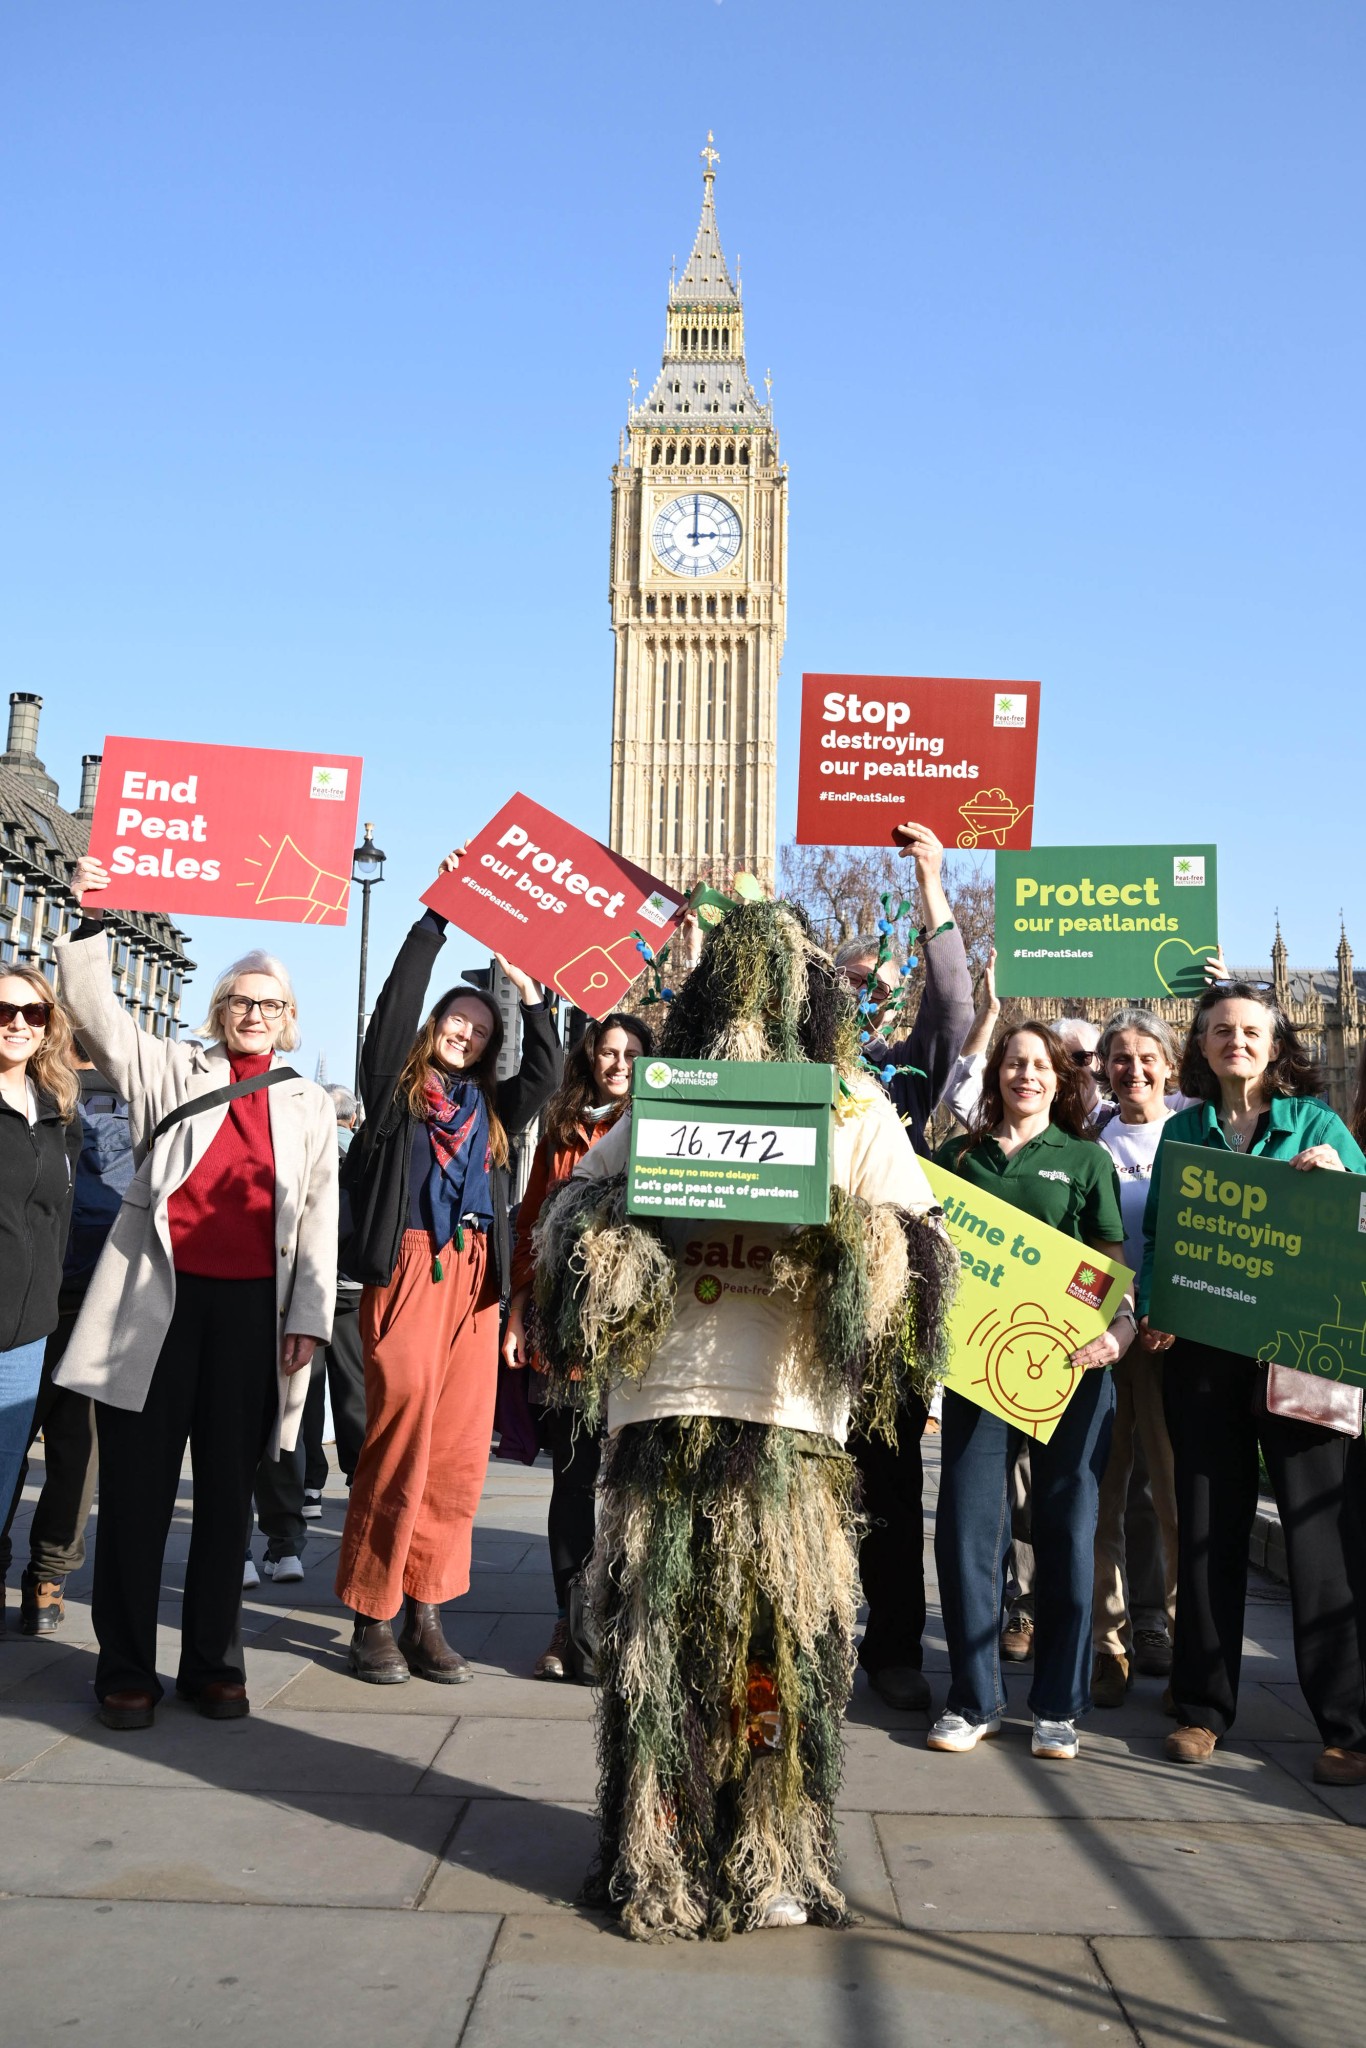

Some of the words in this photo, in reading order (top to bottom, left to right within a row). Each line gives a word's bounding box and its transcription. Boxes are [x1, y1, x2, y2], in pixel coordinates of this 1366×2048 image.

[822, 692, 911, 732] Stop
[820, 730, 945, 757] destroying
[820, 760, 859, 775] our
[864, 758, 979, 781] peatlands
[121, 771, 198, 804] End
[312, 786, 345, 795] Peat-free
[819, 791, 906, 804] #EndPeatSales
[116, 807, 208, 842] Peat
[110, 846, 221, 882] Sales
[496, 824, 626, 919] Protect
[480, 853, 518, 880] our
[515, 873, 568, 914] bogs
[1015, 878, 1161, 906] Protect
[461, 876, 529, 924] #EndPeatSales
[1014, 917, 1054, 932] our
[1058, 913, 1179, 936] peatlands
[1013, 949, 1094, 958] #EndPeatSales
[671, 1069, 718, 1079] Peat-free
[671, 1077, 718, 1086] PARTNERSHIP
[635, 1165, 668, 1176] People
[669, 1169, 685, 1178] say
[700, 1170, 725, 1178] more
[725, 1170, 760, 1182] delays:
[633, 1195, 662, 1204] once
[664, 1196, 687, 1206] and
[688, 1196, 706, 1207] for
[707, 1197, 727, 1209] all.
[663, 1182, 684, 1194] get
[685, 1183, 713, 1195] peat
[714, 1184, 735, 1195] out
[736, 1185, 750, 1196] of
[750, 1187, 799, 1199] gardens
[1180, 1165, 1267, 1219] Stop
[943, 1196, 1005, 1246] time
[1010, 1234, 1041, 1266] to
[1177, 1207, 1302, 1256] destroying
[684, 1234, 773, 1270] sale
[1174, 1240, 1213, 1262] our
[1217, 1244, 1274, 1279] bogs
[1069, 1282, 1102, 1303] Peat-free
[1171, 1274, 1257, 1304] #EndPeatSales
